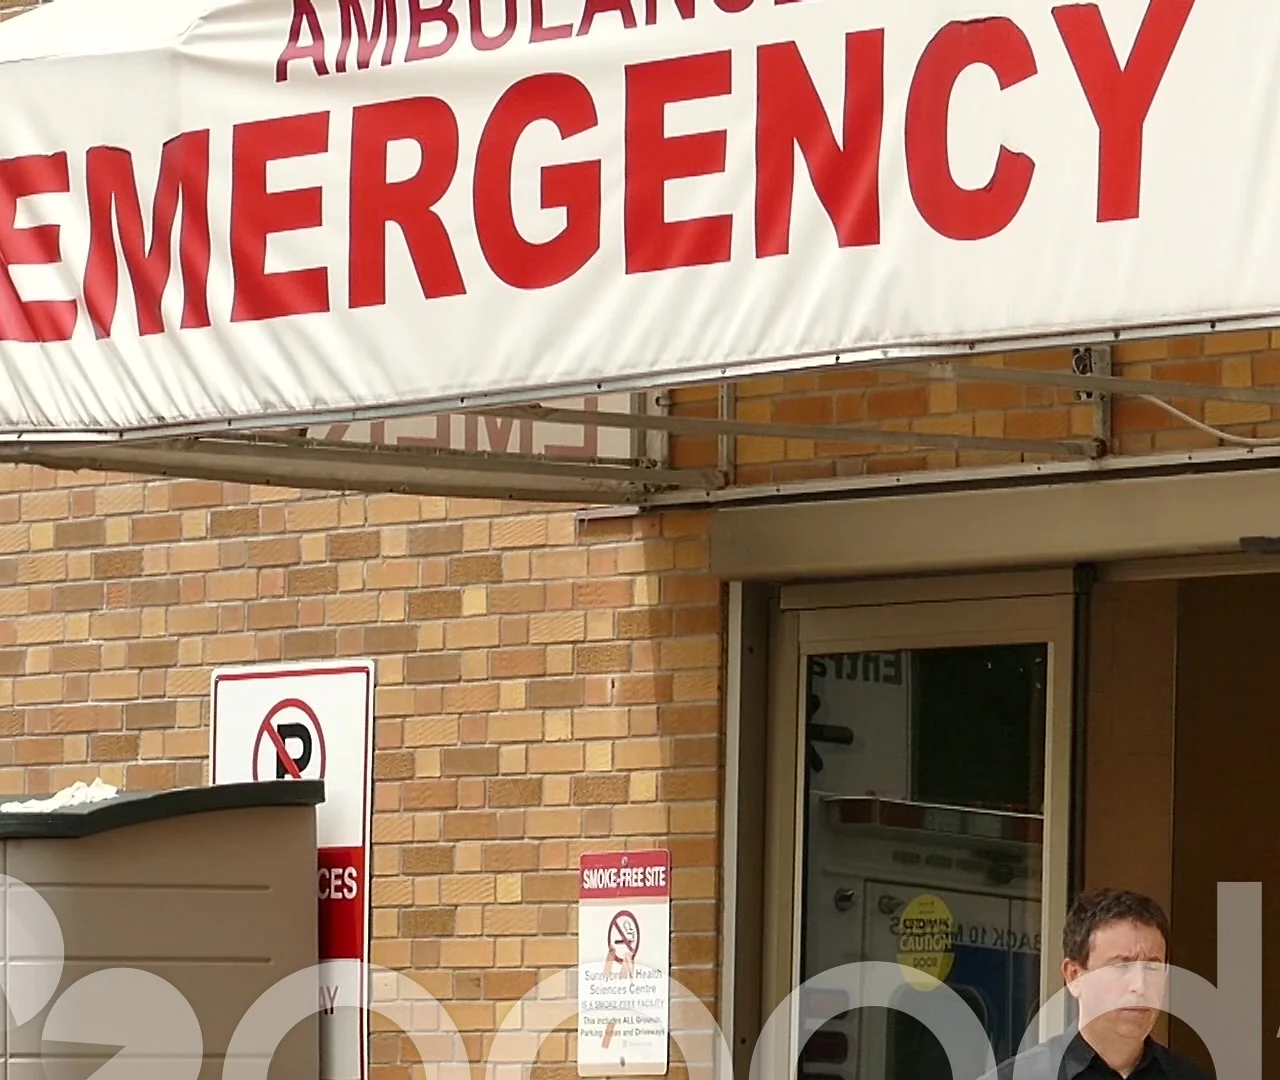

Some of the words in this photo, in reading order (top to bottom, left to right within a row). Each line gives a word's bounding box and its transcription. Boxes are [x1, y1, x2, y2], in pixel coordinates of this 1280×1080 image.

[583, 867, 644, 889] SMOKE-FREE
[645, 866, 666, 887] SITE
[590, 984, 627, 995] Sciences
[629, 983, 657, 995] Centre
